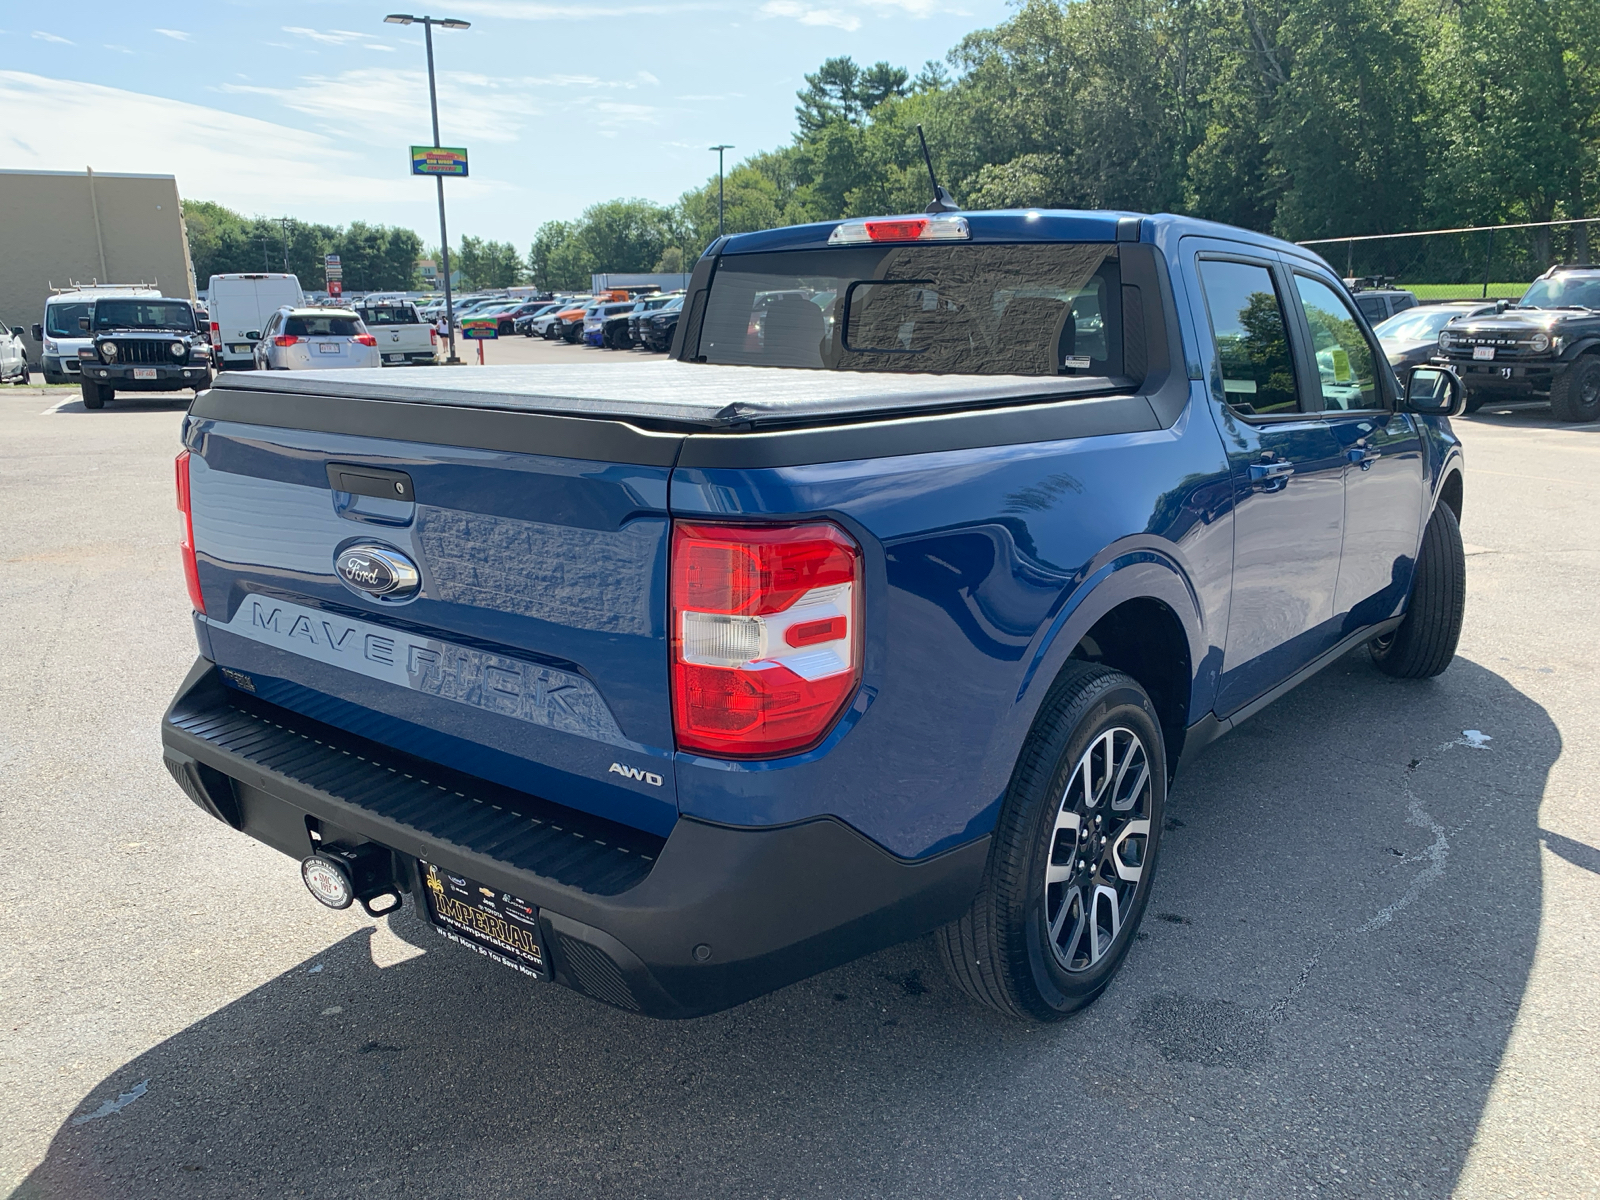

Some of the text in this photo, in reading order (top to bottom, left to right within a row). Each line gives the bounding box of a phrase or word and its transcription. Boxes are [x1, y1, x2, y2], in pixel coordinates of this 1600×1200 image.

[345, 557, 379, 585] Ford
[253, 601, 580, 718] MAVERICK
[608, 762, 664, 787] AWD
[433, 891, 541, 958] IMPERIAL
[438, 913, 543, 966] www.imperialcars.com
[436, 926, 538, 979] We Sell More, So You Save More
